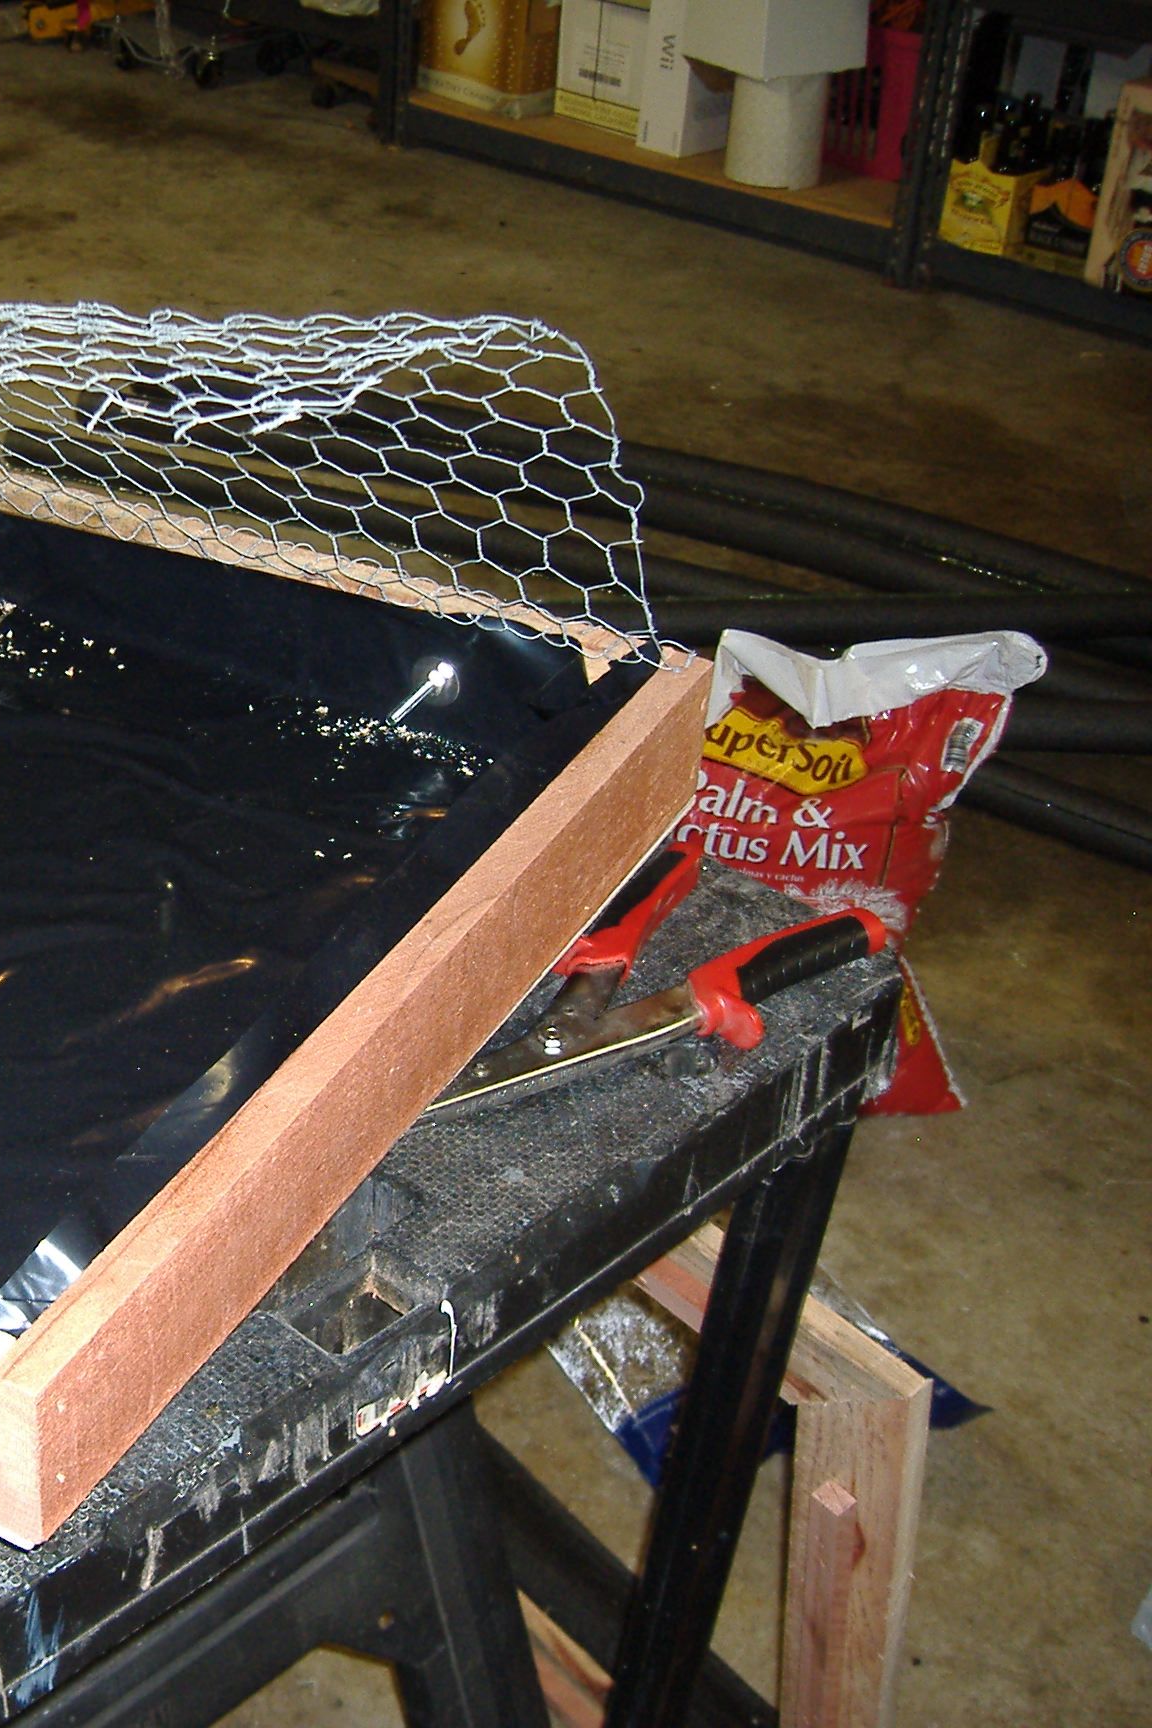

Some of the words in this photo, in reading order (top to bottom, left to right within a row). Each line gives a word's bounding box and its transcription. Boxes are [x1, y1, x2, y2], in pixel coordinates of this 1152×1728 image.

[659, 34, 678, 71] Wii
[706, 723, 853, 784] uperSoil
[793, 797, 833, 829] &
[779, 830, 869, 870] Mix
